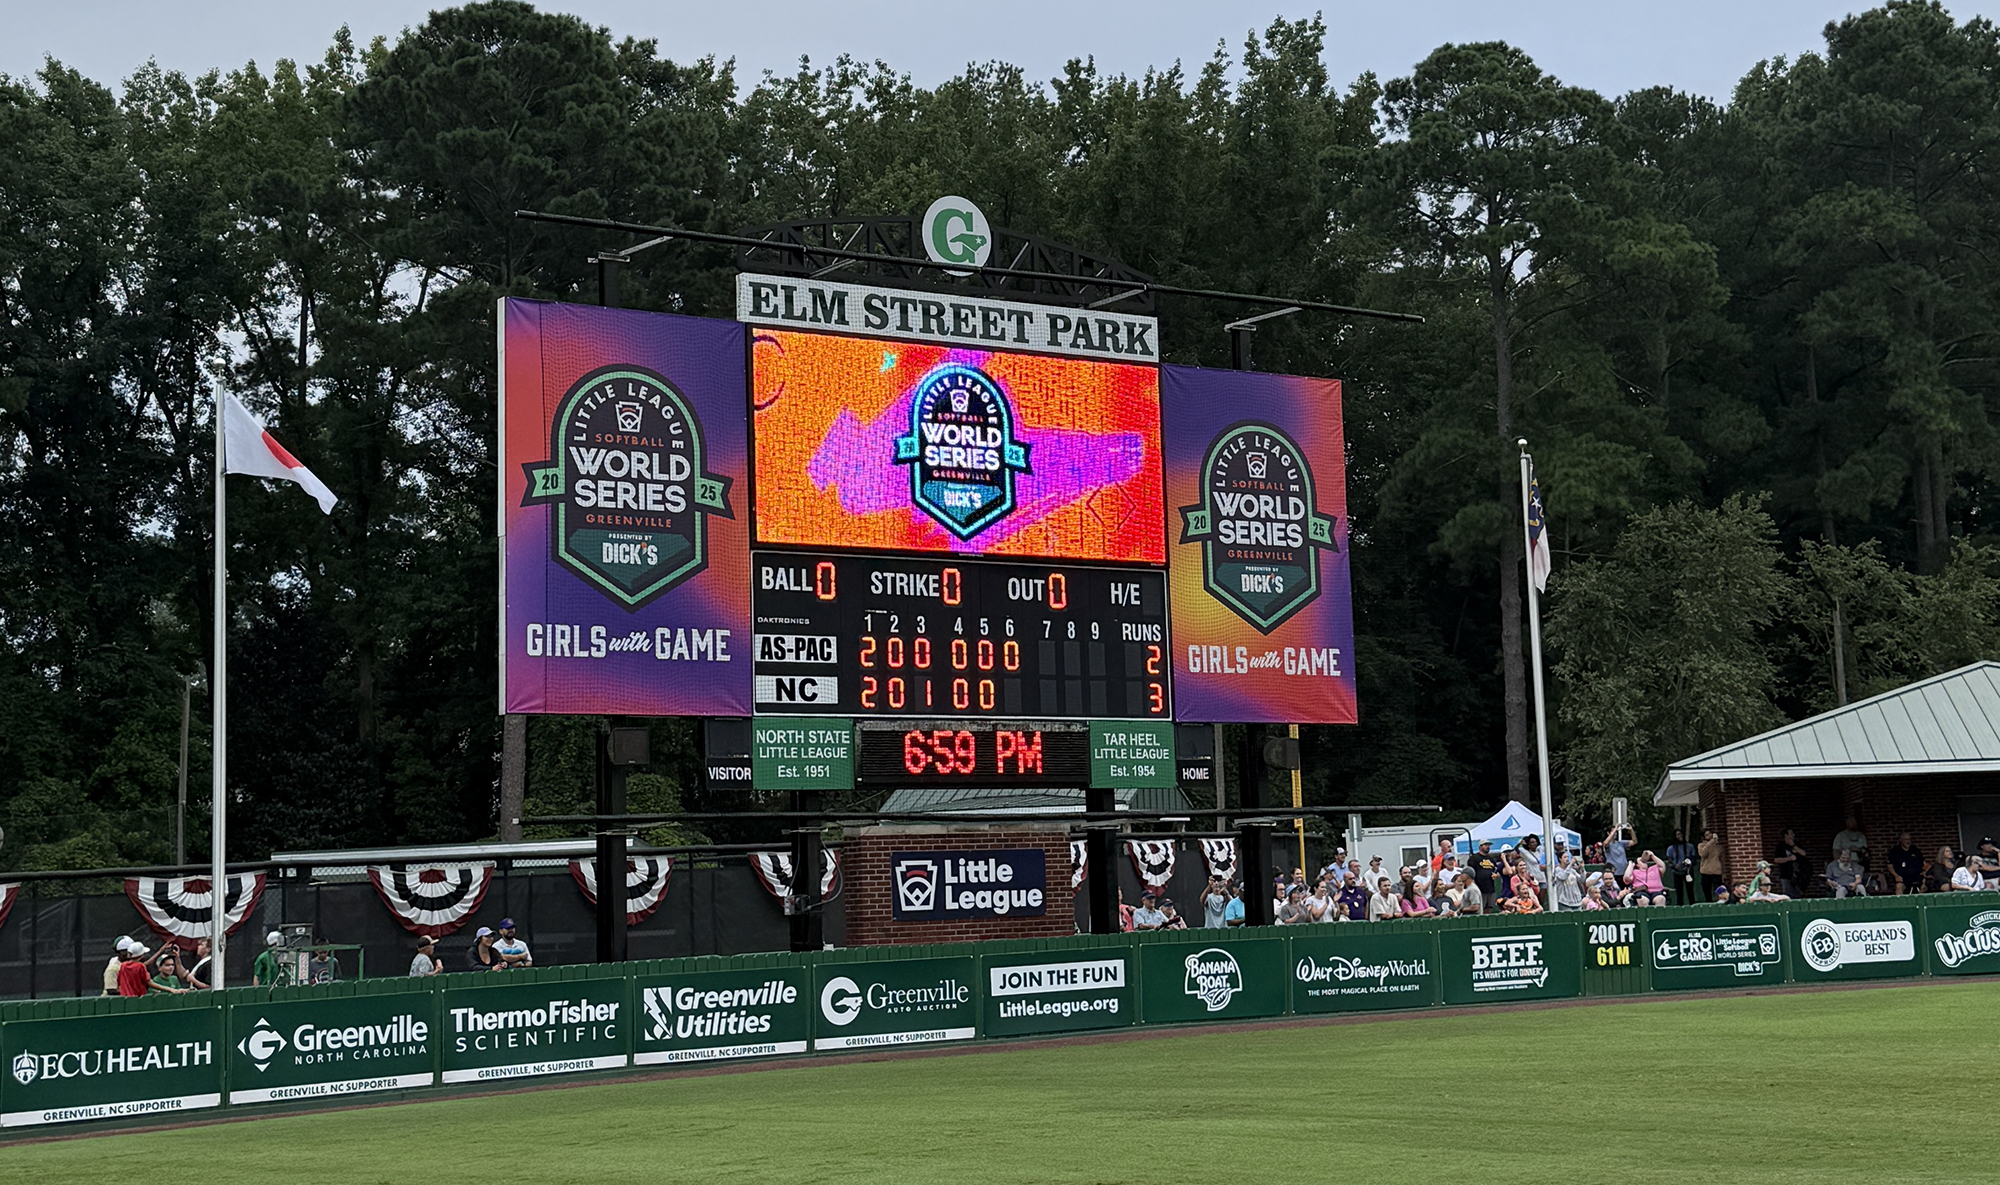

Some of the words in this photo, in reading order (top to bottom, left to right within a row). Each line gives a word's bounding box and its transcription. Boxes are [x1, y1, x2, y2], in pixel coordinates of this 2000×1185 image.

[748, 281, 850, 326] ELM
[864, 293, 1033, 345] STREET
[1047, 314, 1154, 356] PARK
[923, 377, 950, 419] LITTLE
[958, 376, 997, 424] LEAGUE
[574, 383, 616, 441] LITTLE
[628, 383, 684, 449] LEAGUE
[595, 432, 665, 448] SOFTBALL
[921, 422, 1002, 447] WORLD
[569, 446, 691, 483] WORLD
[925, 445, 1000, 470] SERIES
[1215, 436, 1246, 487] LITTLE
[1255, 435, 1299, 492] LEAGUE
[541, 473, 559, 491] 20
[700, 483, 717, 502] 25
[1232, 479, 1284, 491] SOFTBALL
[574, 480, 686, 513] SERIES
[1212, 491, 1305, 522] WORLD
[586, 513, 672, 528] GREENVILLE
[1193, 515, 1206, 530] 20
[1313, 522, 1325, 537] 25
[1218, 519, 1303, 547] SERIES
[602, 542, 658, 566] DICK'S
[1227, 550, 1293, 561] GREENVILLE
[761, 566, 813, 591] BALL
[816, 562, 836, 600] 0
[870, 571, 940, 598] STRIKE
[942, 567, 961, 605] 0
[1007, 577, 1045, 601] OUT
[1048, 572, 1066, 610] 0
[1241, 573, 1284, 594] DICK'S
[1110, 582, 1141, 607] H/E
[757, 616, 810, 625] DAKTRONICS
[864, 613, 872, 632] 1
[890, 615, 899, 633] 2
[917, 616, 926, 634] 3
[954, 617, 963, 635] 4
[980, 618, 989, 636] 5
[1005, 619, 1014, 637] 6
[1042, 620, 1051, 638] 7
[1067, 621, 1075, 639] 8
[1091, 622, 1099, 640] 9
[1122, 623, 1162, 642] RUNS
[526, 623, 606, 659] GIRLS
[609, 632, 654, 652] with
[655, 627, 731, 662] GAME
[760, 636, 832, 662] AS-PAC
[860, 636, 876, 667] 2
[887, 637, 904, 668] 0
[914, 637, 931, 668] 0
[951, 639, 967, 670] 0
[977, 639, 994, 670] 0
[1003, 640, 1019, 671] 0
[1146, 645, 1161, 675] 2
[1188, 645, 1248, 673] GIRLS
[1250, 651, 1283, 669] with
[1283, 647, 1341, 676] GAME
[775, 678, 818, 703] NC
[861, 676, 877, 708] 2
[888, 677, 905, 709] 0
[926, 679, 932, 706] 1
[953, 678, 969, 709] 0
[979, 679, 995, 710] 0
[1149, 683, 1163, 713] 3
[756, 730, 804, 744] NORTH
[808, 731, 850, 744] STATE
[1103, 733, 1127, 746] TAR
[1130, 734, 1160, 746] HEEL
[759, 747, 798, 758] LITTLE
[801, 747, 847, 758] LEAGUE
[904, 730, 976, 774] 6:59
[996, 731, 1042, 774] PM
[1095, 748, 1127, 759] LITTLE
[1130, 749, 1169, 760] LEAGUE
[708, 767, 752, 780] VISITOR
[777, 765, 800, 778] Est.
[803, 765, 830, 777] 1951
[1110, 765, 1129, 777] Est.
[1132, 765, 1155, 777] 1954
[1182, 768, 1210, 780] HOME
[944, 858, 1014, 884] Little
[945, 885, 1043, 915] League
[1973, 912, 2000, 925] SMUCK
[1589, 924, 1617, 944] 200
[1620, 923, 1636, 943] FT
[1471, 941, 1544, 970] BEEF.
[1597, 947, 1614, 966] 61
[1617, 946, 1630, 965] M
[1679, 938, 1712, 953] PRO
[1680, 951, 1713, 961] GAMES
[1812, 937, 1834, 955] EB
[1865, 943, 1891, 956] BEST
[1937, 929, 2000, 965] Uncrus
[999, 971, 1042, 989] JOIN
[1047, 968, 1078, 986] THE
[1083, 965, 1118, 983] FUN
[1188, 958, 1236, 978] BANANA
[1506, 969, 1519, 978] FOR
[675, 980, 797, 1011] Greenville
[866, 979, 969, 1010] Greenville
[1308, 989, 1320, 997] THE
[1321, 988, 1339, 996] MOST
[1341, 987, 1368, 995] MAGICAL
[1370, 985, 1388, 993] PLACE
[1400, 984, 1419, 992] EARTH
[887, 1006, 912, 1014] AUTO
[916, 1003, 958, 1012] AUCTION
[999, 997, 1119, 1018] LittleLeague.org
[293, 1014, 428, 1051] Greenville
[676, 1010, 772, 1039] Utilities
[455, 1024, 617, 1053] SCIENTIFIC
[107, 1041, 212, 1074] HEALTH
[294, 1052, 344, 1065] NORTH
[354, 1044, 427, 1060] CAROLINA
[533, 1064, 546, 1073] NC
[547, 1060, 594, 1072] SUPPORTER
[270, 1085, 328, 1099] GREENVILLE,
[330, 1083, 344, 1092] NC
[346, 1078, 398, 1091] SUPPORTER
[43, 1106, 107, 1121] GREENVILLE,
[109, 1104, 124, 1114] NC
[126, 1099, 182, 1113] SUPPORTER
